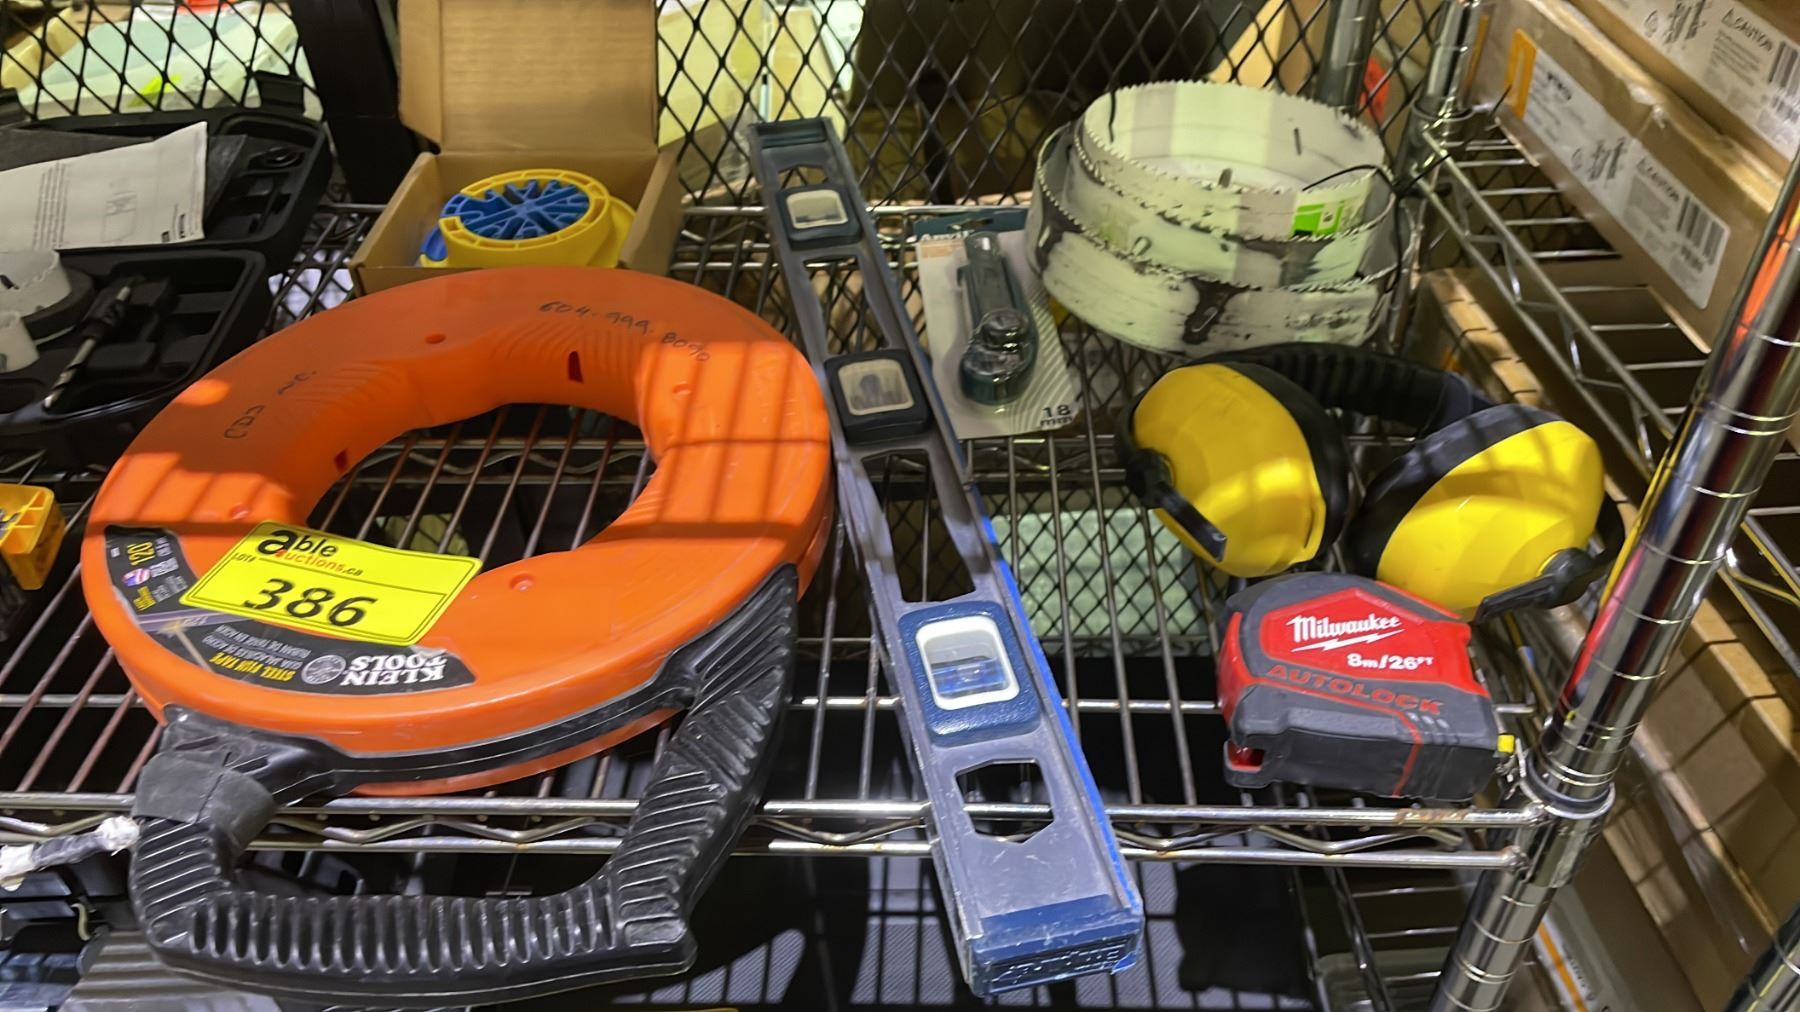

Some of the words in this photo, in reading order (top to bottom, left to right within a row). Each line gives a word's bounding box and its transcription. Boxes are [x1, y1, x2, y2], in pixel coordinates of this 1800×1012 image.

[1043, 404, 1071, 418] 18
[1040, 416, 1073, 427] mm
[257, 529, 338, 557] able
[242, 578, 378, 627] 386
[1286, 613, 1402, 643] Milwaukee
[208, 652, 240, 669] TAPE
[350, 654, 448, 671] TOOLS
[260, 665, 296, 682] STEEL
[340, 665, 445, 686] KLEIN
[1266, 664, 1444, 716] AUTOLOCK
